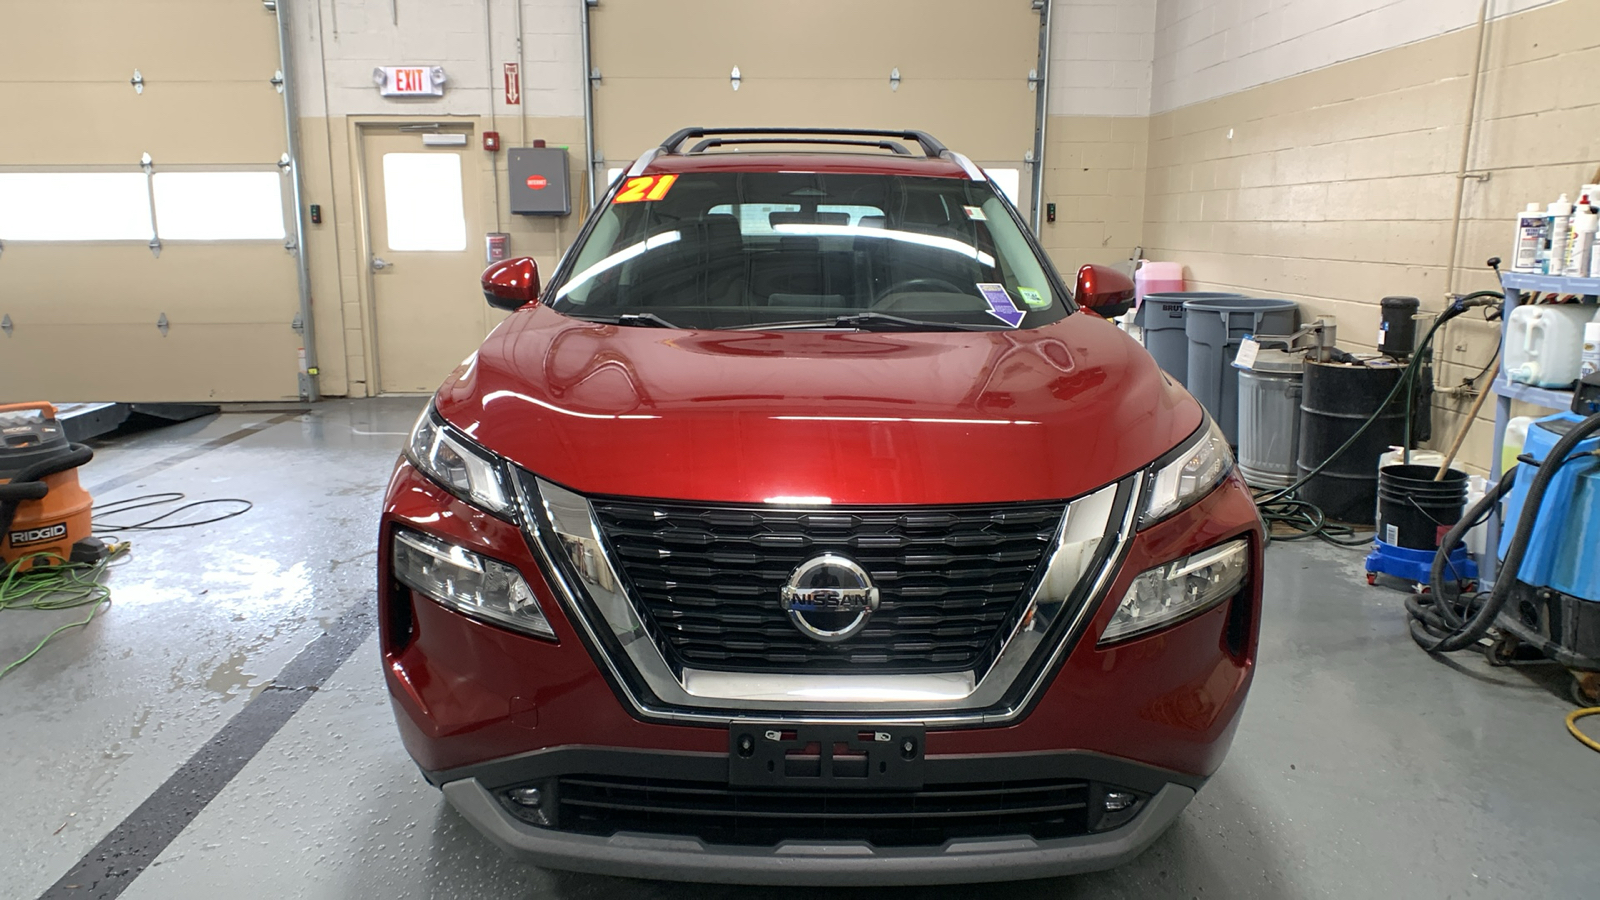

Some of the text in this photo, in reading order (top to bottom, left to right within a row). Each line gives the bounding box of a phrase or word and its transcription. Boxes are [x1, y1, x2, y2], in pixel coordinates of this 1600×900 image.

[395, 69, 423, 91] EXIT
[616, 174, 675, 202] 21
[11, 524, 66, 543] RIDGID
[792, 592, 869, 605] NISSAN
